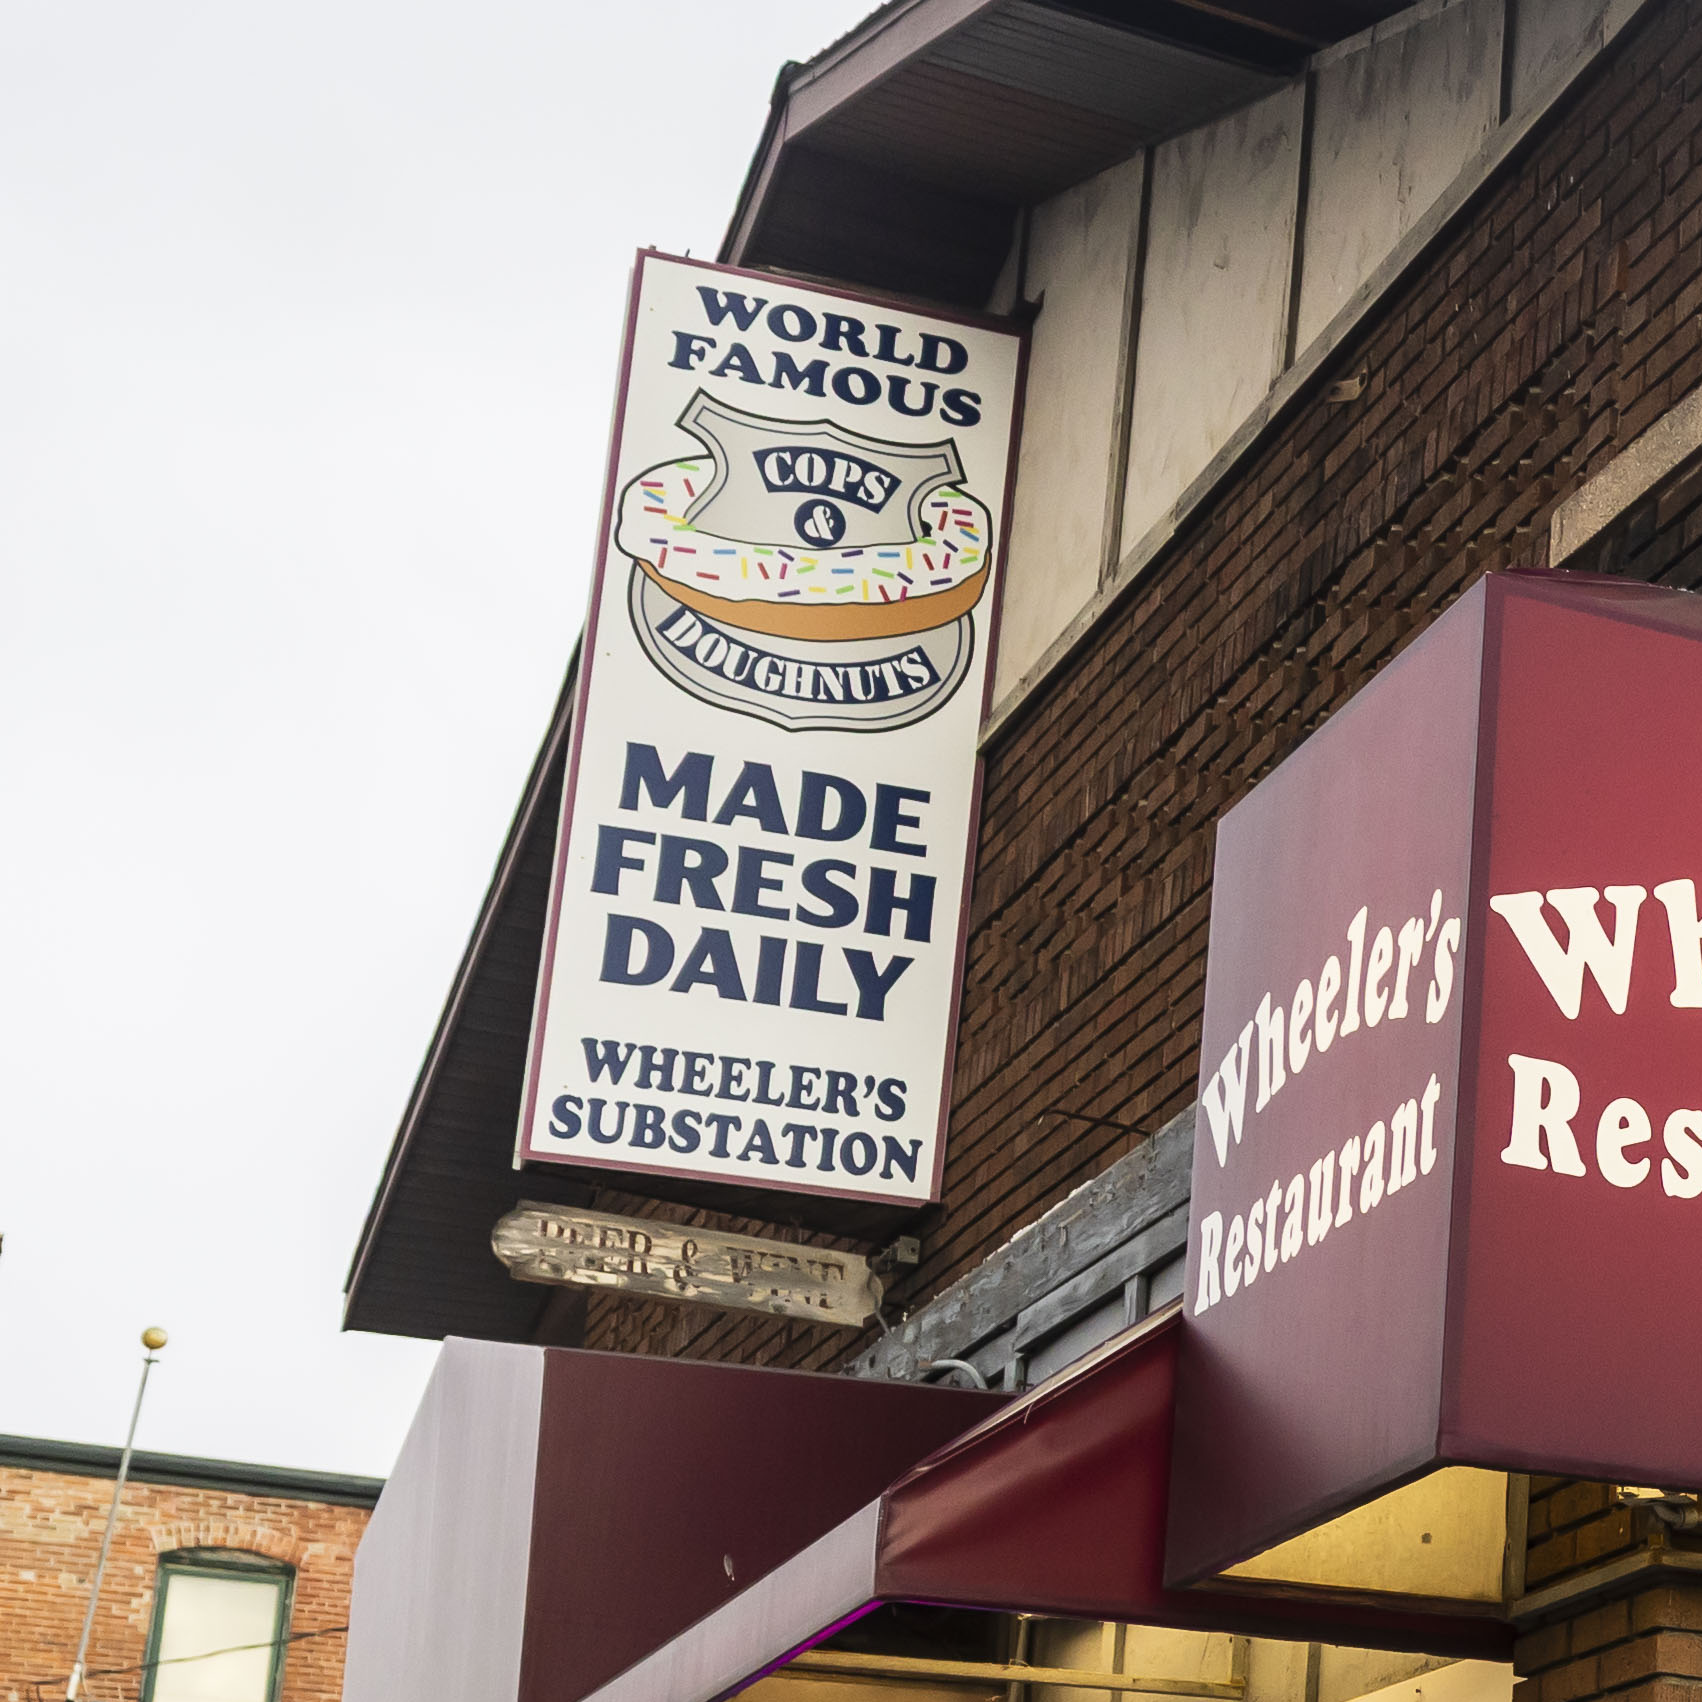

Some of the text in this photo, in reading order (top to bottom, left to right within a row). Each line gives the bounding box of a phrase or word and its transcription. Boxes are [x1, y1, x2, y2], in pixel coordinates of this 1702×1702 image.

[667, 329, 983, 428] FAMOUS
[695, 285, 970, 376] WORLD
[763, 450, 892, 506] COPS
[803, 505, 835, 542] &
[661, 609, 931, 702] DOUGHNUTS
[618, 742, 932, 858] MADE
[590, 825, 937, 944] FRESH
[599, 913, 916, 1022] DAILY
[1202, 888, 1461, 1168] Wheeler's
[580, 1037, 908, 1123] WHEELER'S
[548, 1093, 923, 1184] SUBSTATION
[1194, 1073, 1441, 1317] Restaurant
